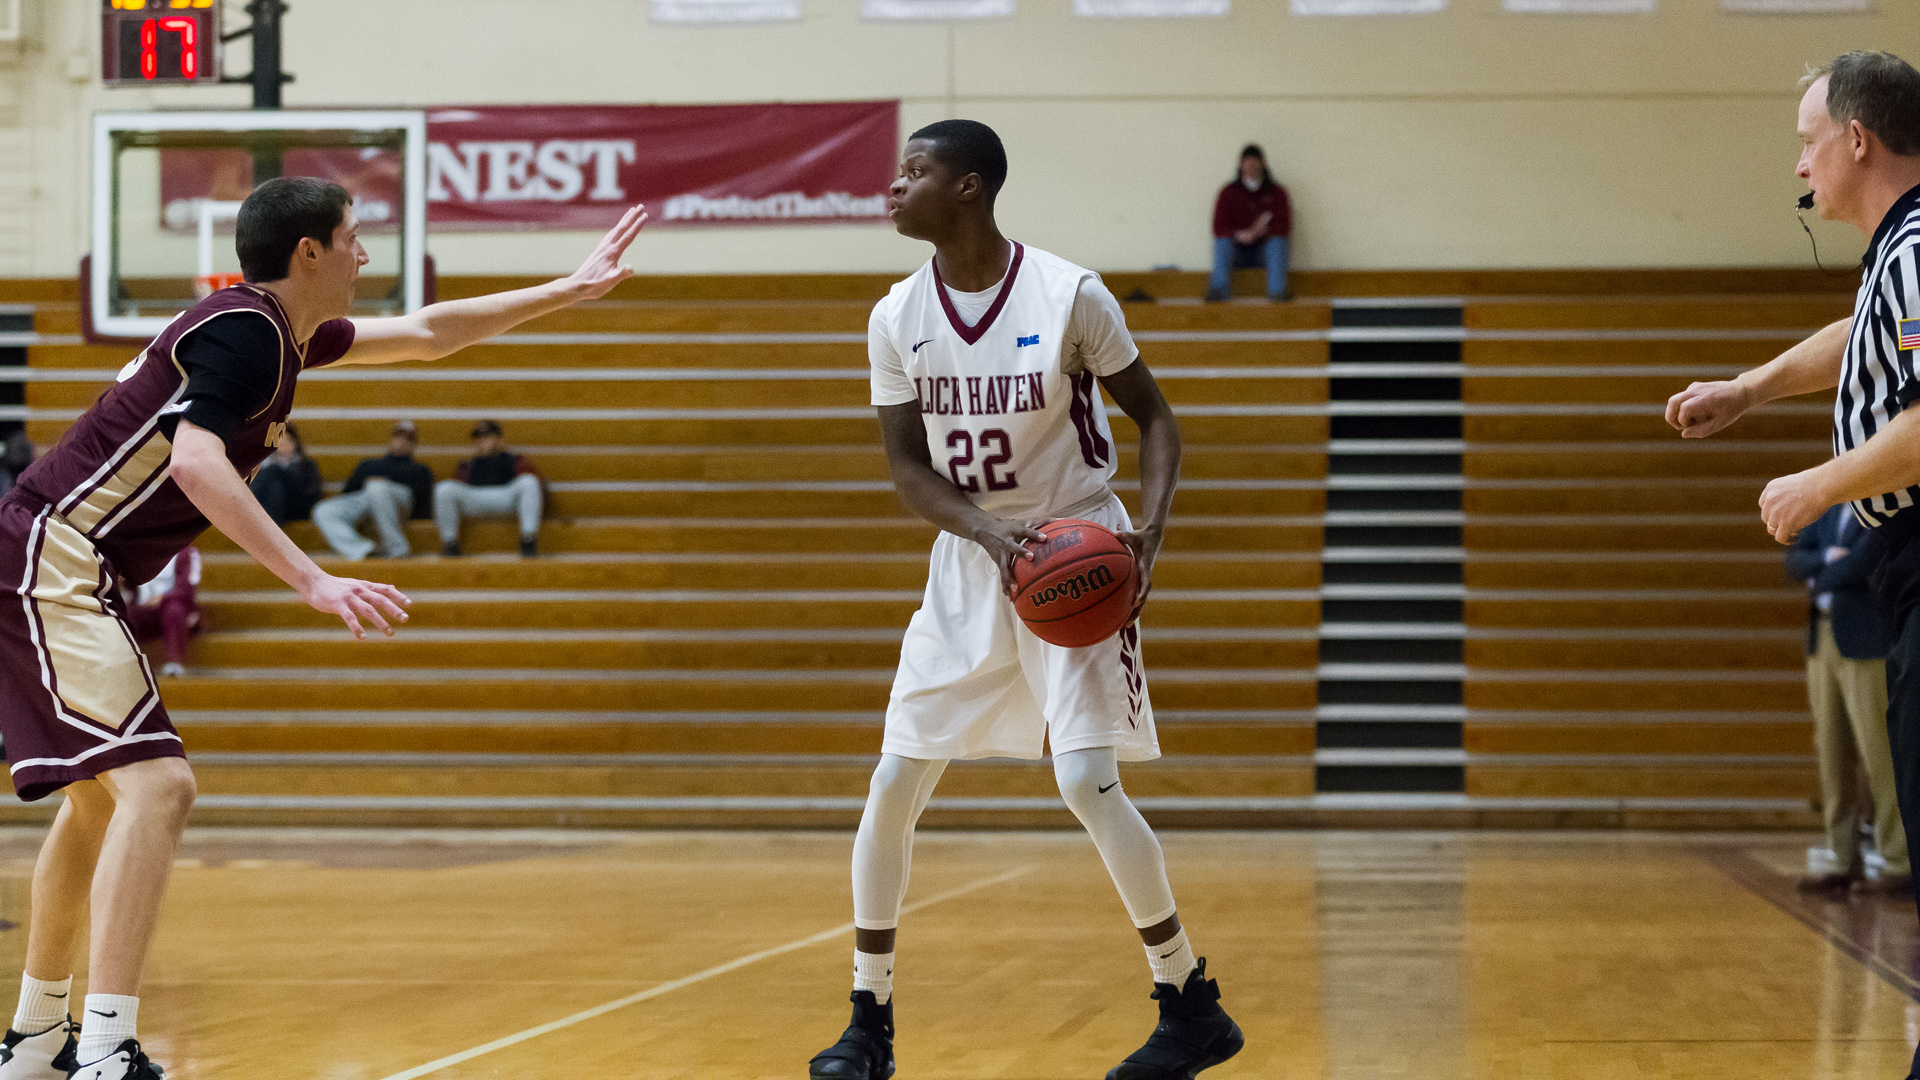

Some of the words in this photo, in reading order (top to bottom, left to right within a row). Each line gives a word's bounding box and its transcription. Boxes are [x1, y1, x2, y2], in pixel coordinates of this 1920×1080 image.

[140, 16, 197, 80] 17
[427, 139, 636, 202] NEST
[966, 371, 1047, 416] HAVEN
[946, 428, 1020, 494] 22
[1029, 564, 1116, 608] Wilson
